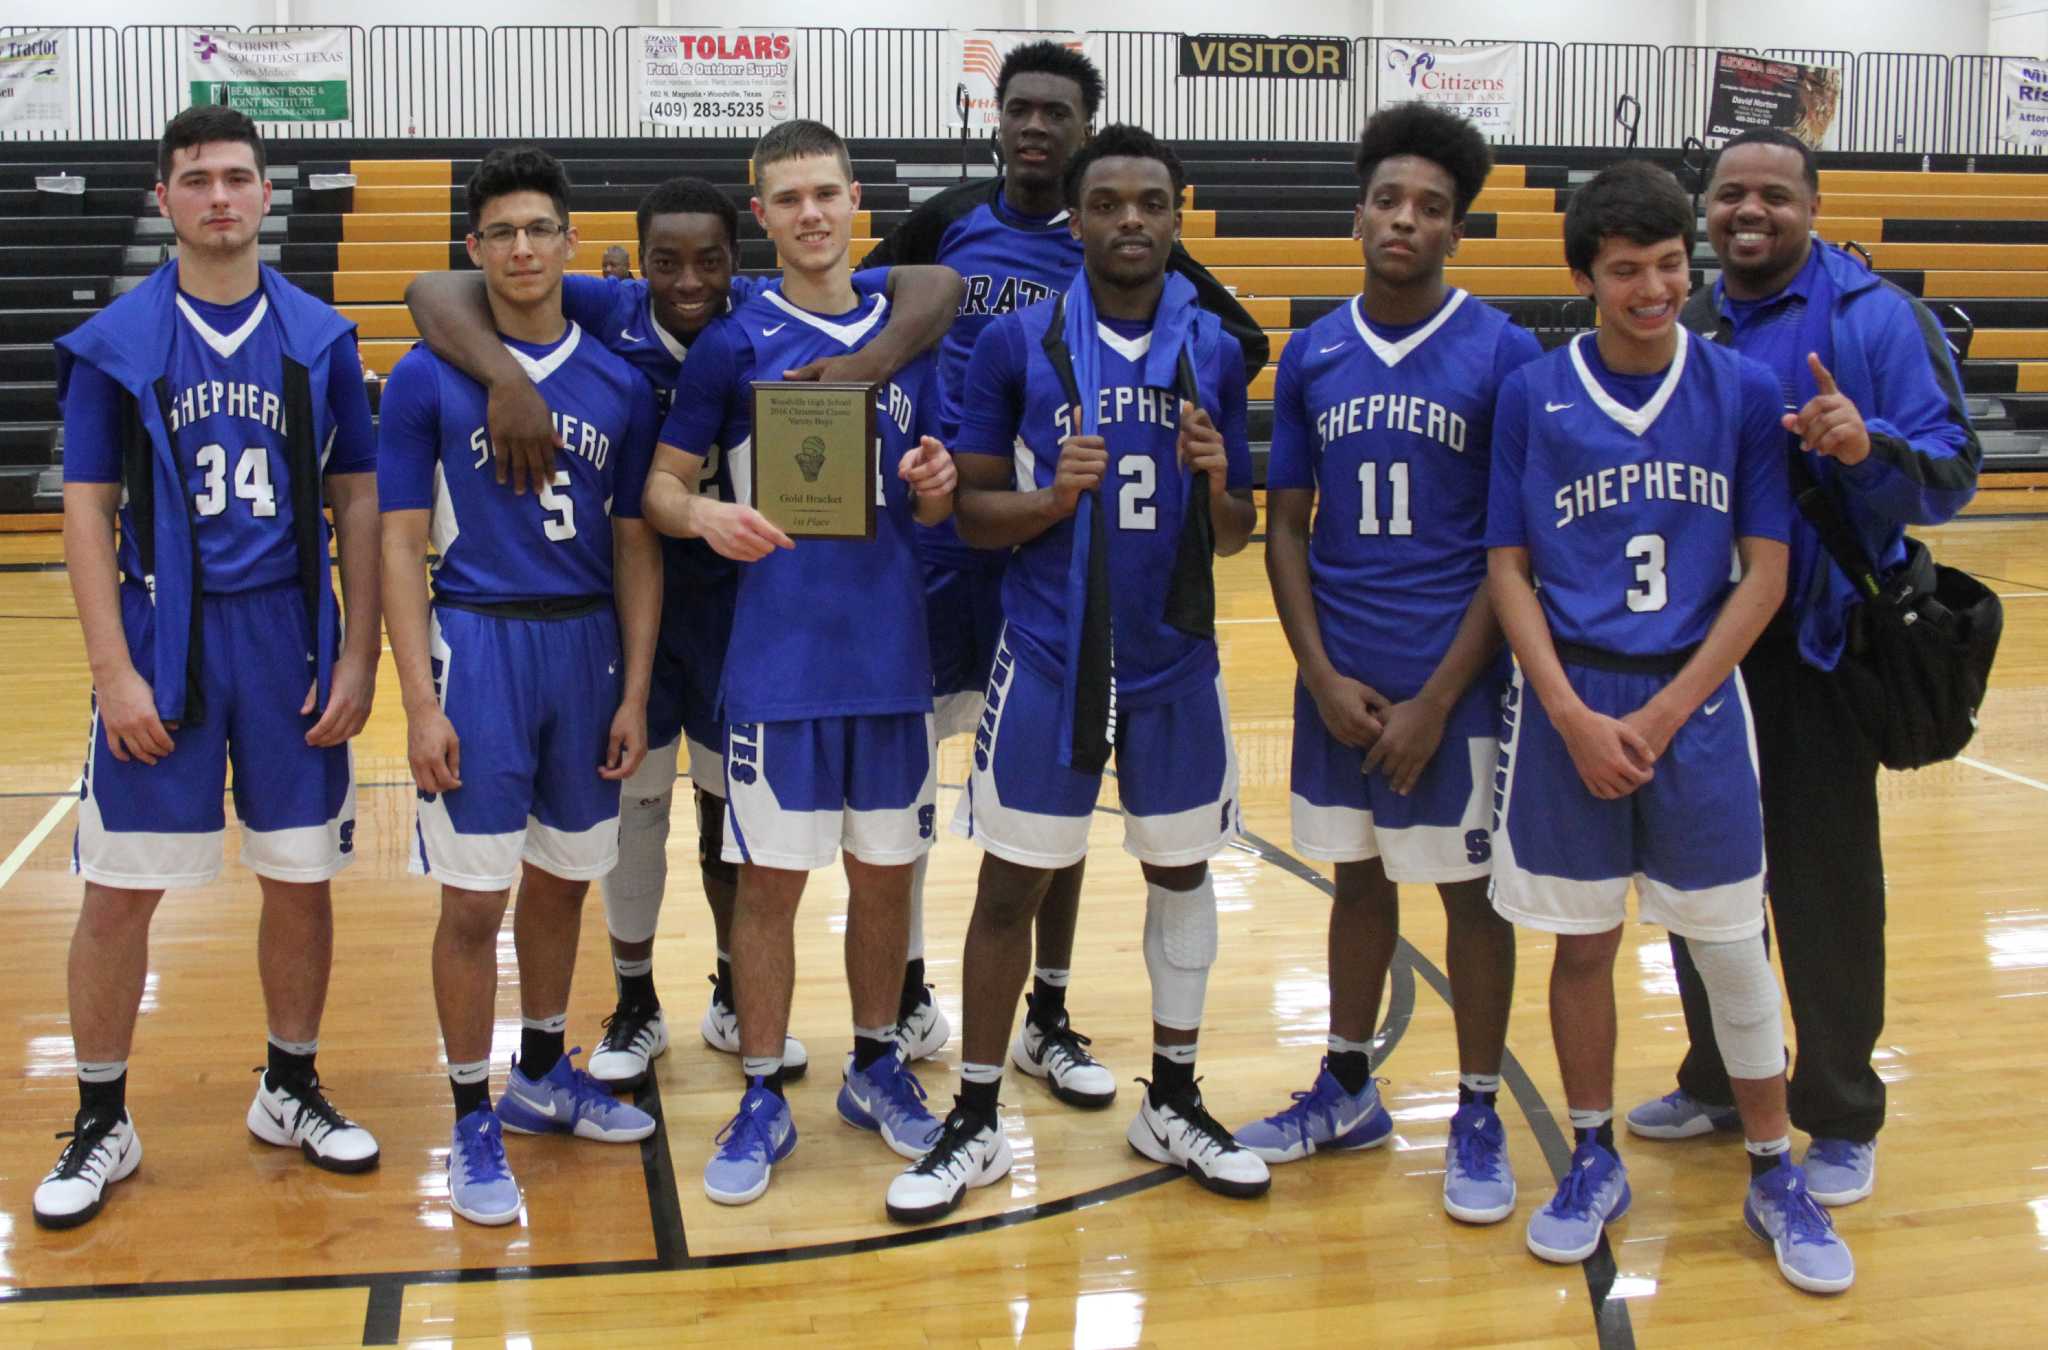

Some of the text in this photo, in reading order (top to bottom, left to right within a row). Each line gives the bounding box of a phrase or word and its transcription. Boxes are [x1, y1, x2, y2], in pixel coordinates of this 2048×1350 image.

[8, 39, 58, 58] Tractor
[304, 52, 344, 62] TEXAS
[680, 33, 791, 60] TOLAR'S
[1191, 41, 1341, 75] VISITOR
[694, 63, 745, 76] Outdoor
[747, 63, 788, 78] Supply
[1421, 71, 1505, 90] Citizens
[231, 86, 286, 96] BEAUMONT
[288, 86, 317, 96] BONE
[231, 98, 314, 108] JOINT INSTITUTE
[649, 102, 764, 120] (409) 283-5235
[169, 379, 288, 438] SHEPHER
[1317, 394, 1467, 452] SHEPHERD
[195, 444, 276, 517] 34
[1118, 455, 1156, 529] 2
[1555, 462, 1729, 528] SHEPHERD
[539, 471, 577, 541] 5
[779, 494, 804, 504] Gold
[1358, 462, 1412, 535] 11
[1626, 534, 1668, 612] 3
[1465, 828, 1491, 864] S
